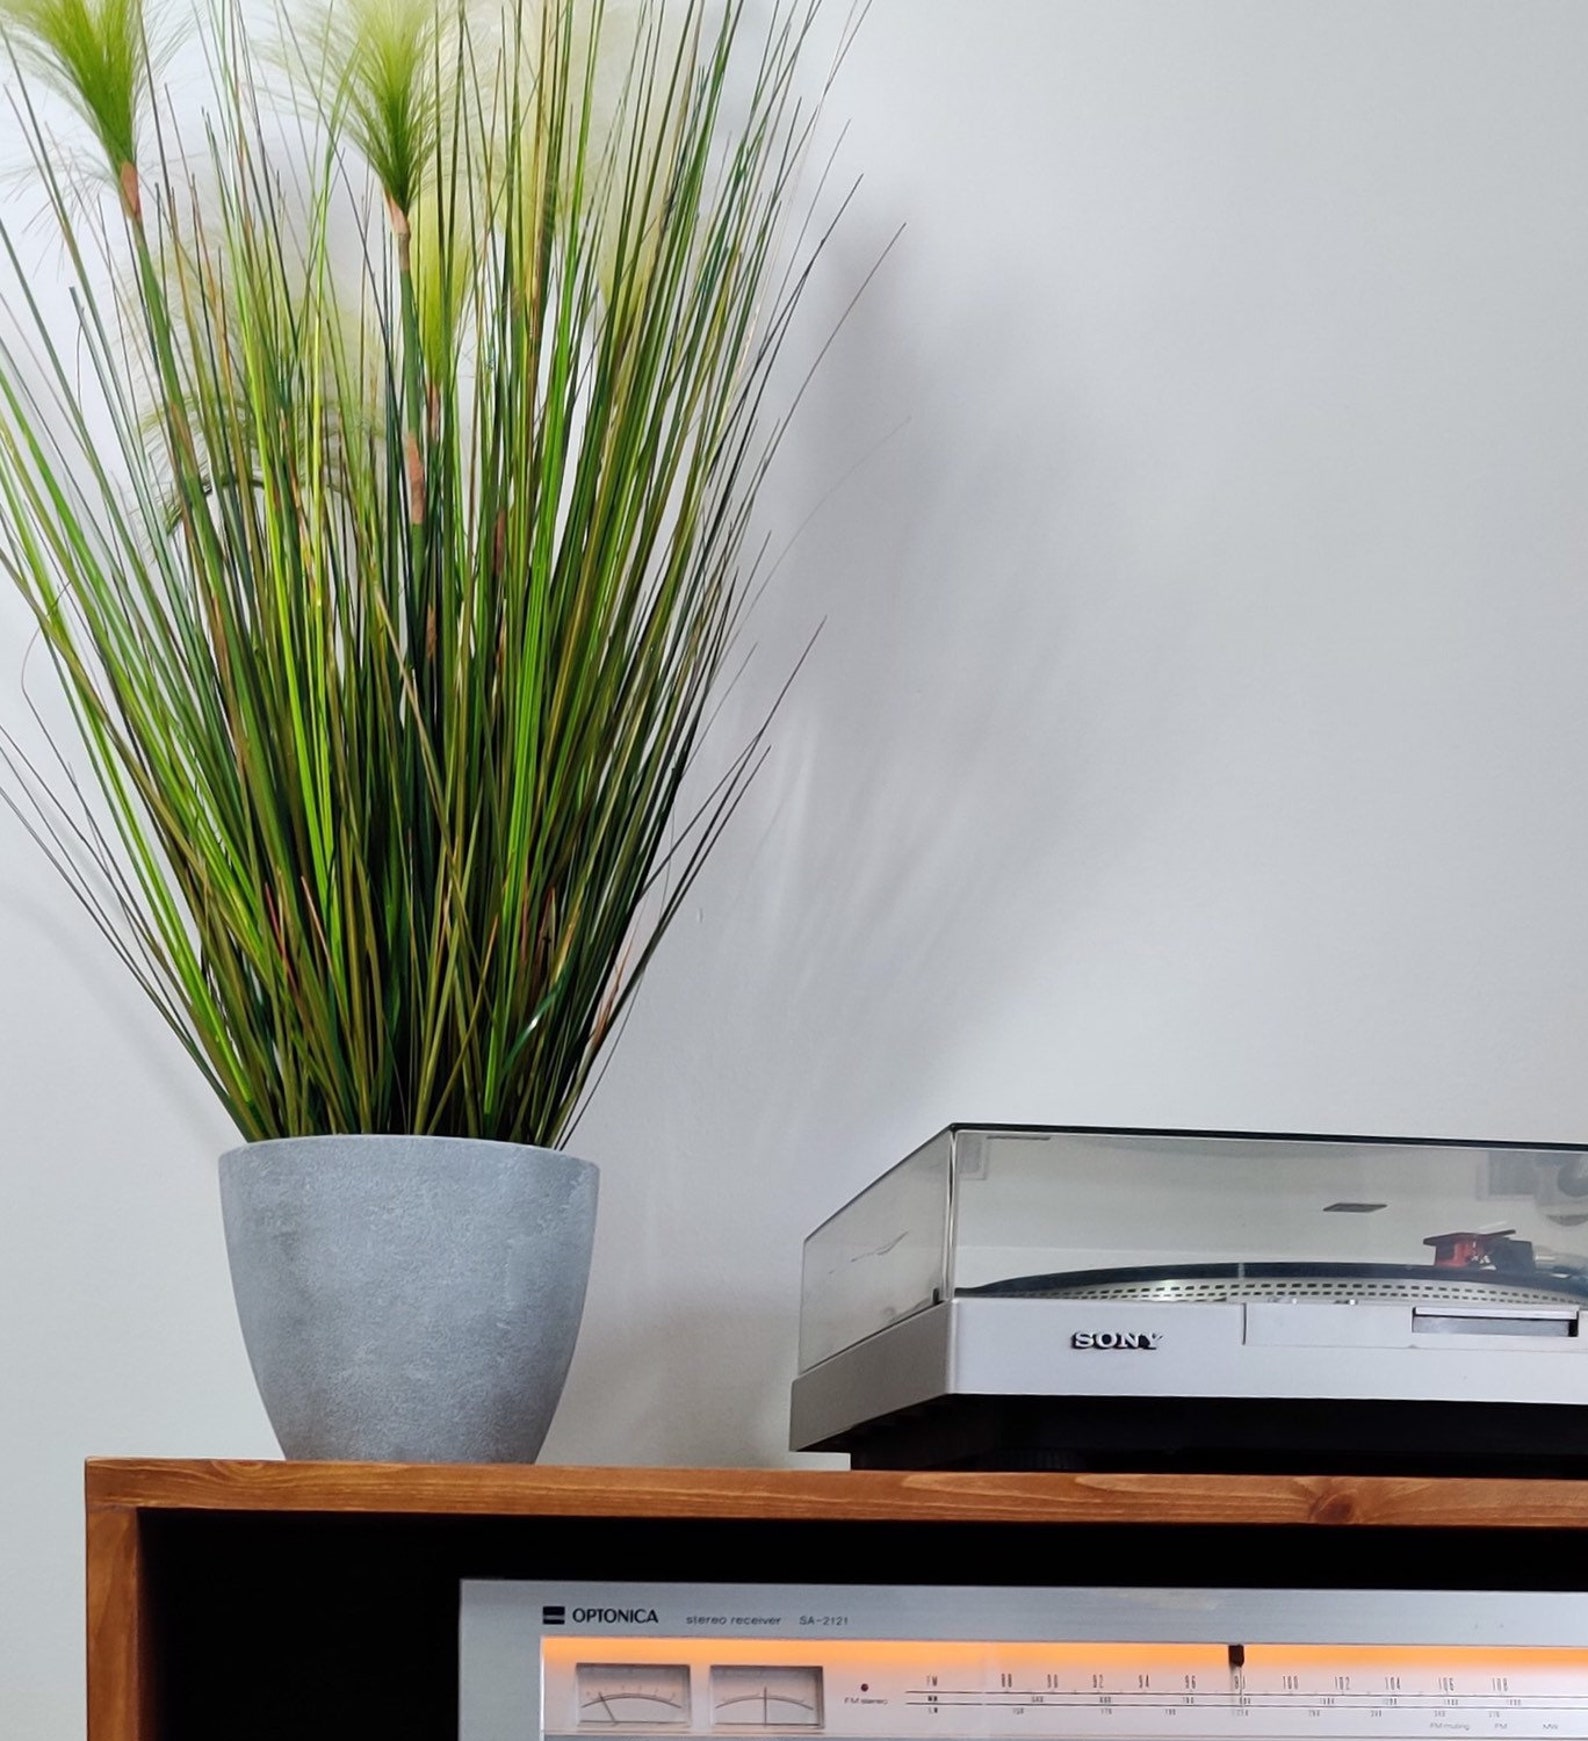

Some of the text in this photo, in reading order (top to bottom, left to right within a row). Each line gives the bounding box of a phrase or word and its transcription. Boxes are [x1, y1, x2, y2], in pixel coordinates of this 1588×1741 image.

[1072, 1330, 1163, 1350] SONY
[572, 1607, 659, 1624] OPTONICA
[686, 1615, 782, 1626] stereo receiver
[799, 1615, 849, 1626] SA-2121
[1335, 1676, 1351, 1691] 102
[1385, 1676, 1401, 1691] 104
